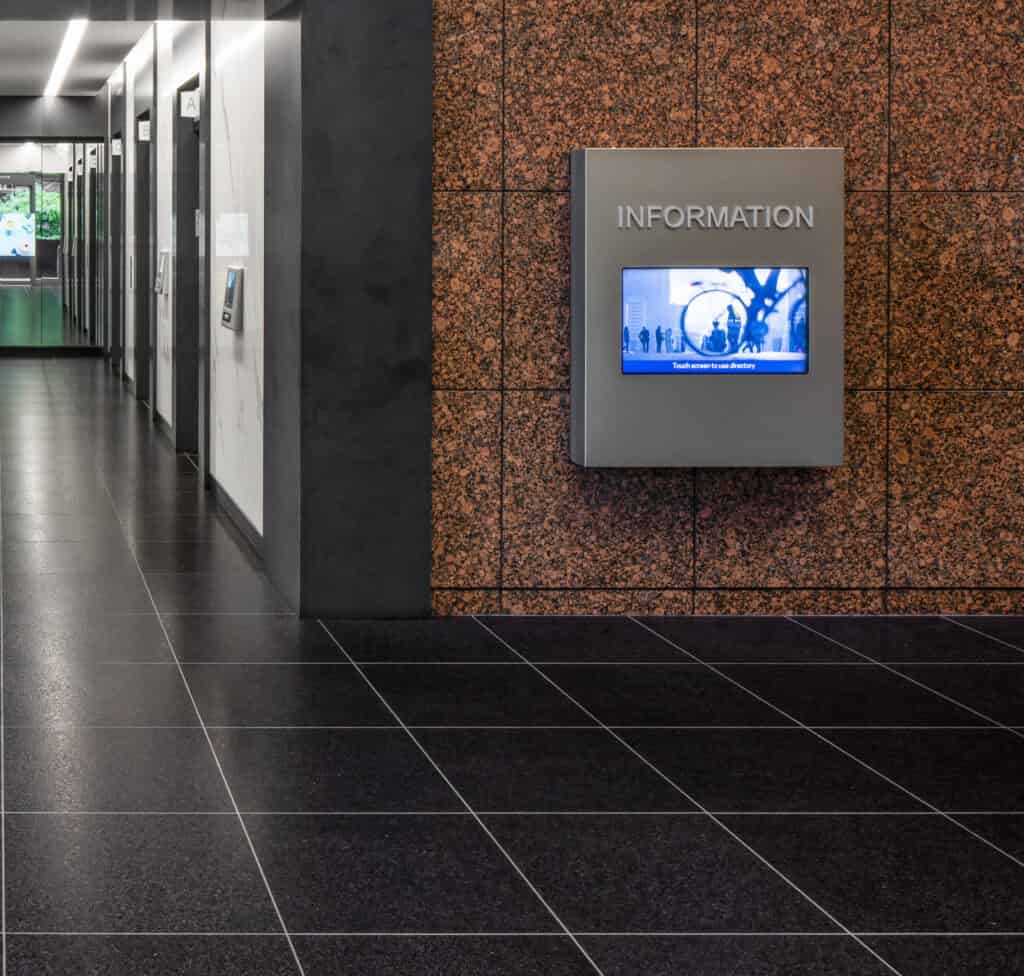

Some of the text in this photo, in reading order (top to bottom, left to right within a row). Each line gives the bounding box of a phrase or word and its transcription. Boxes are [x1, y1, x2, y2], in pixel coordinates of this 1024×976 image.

[187, 97, 197, 112] A
[617, 205, 814, 228] INFORMATION
[730, 362, 756, 370] directory
